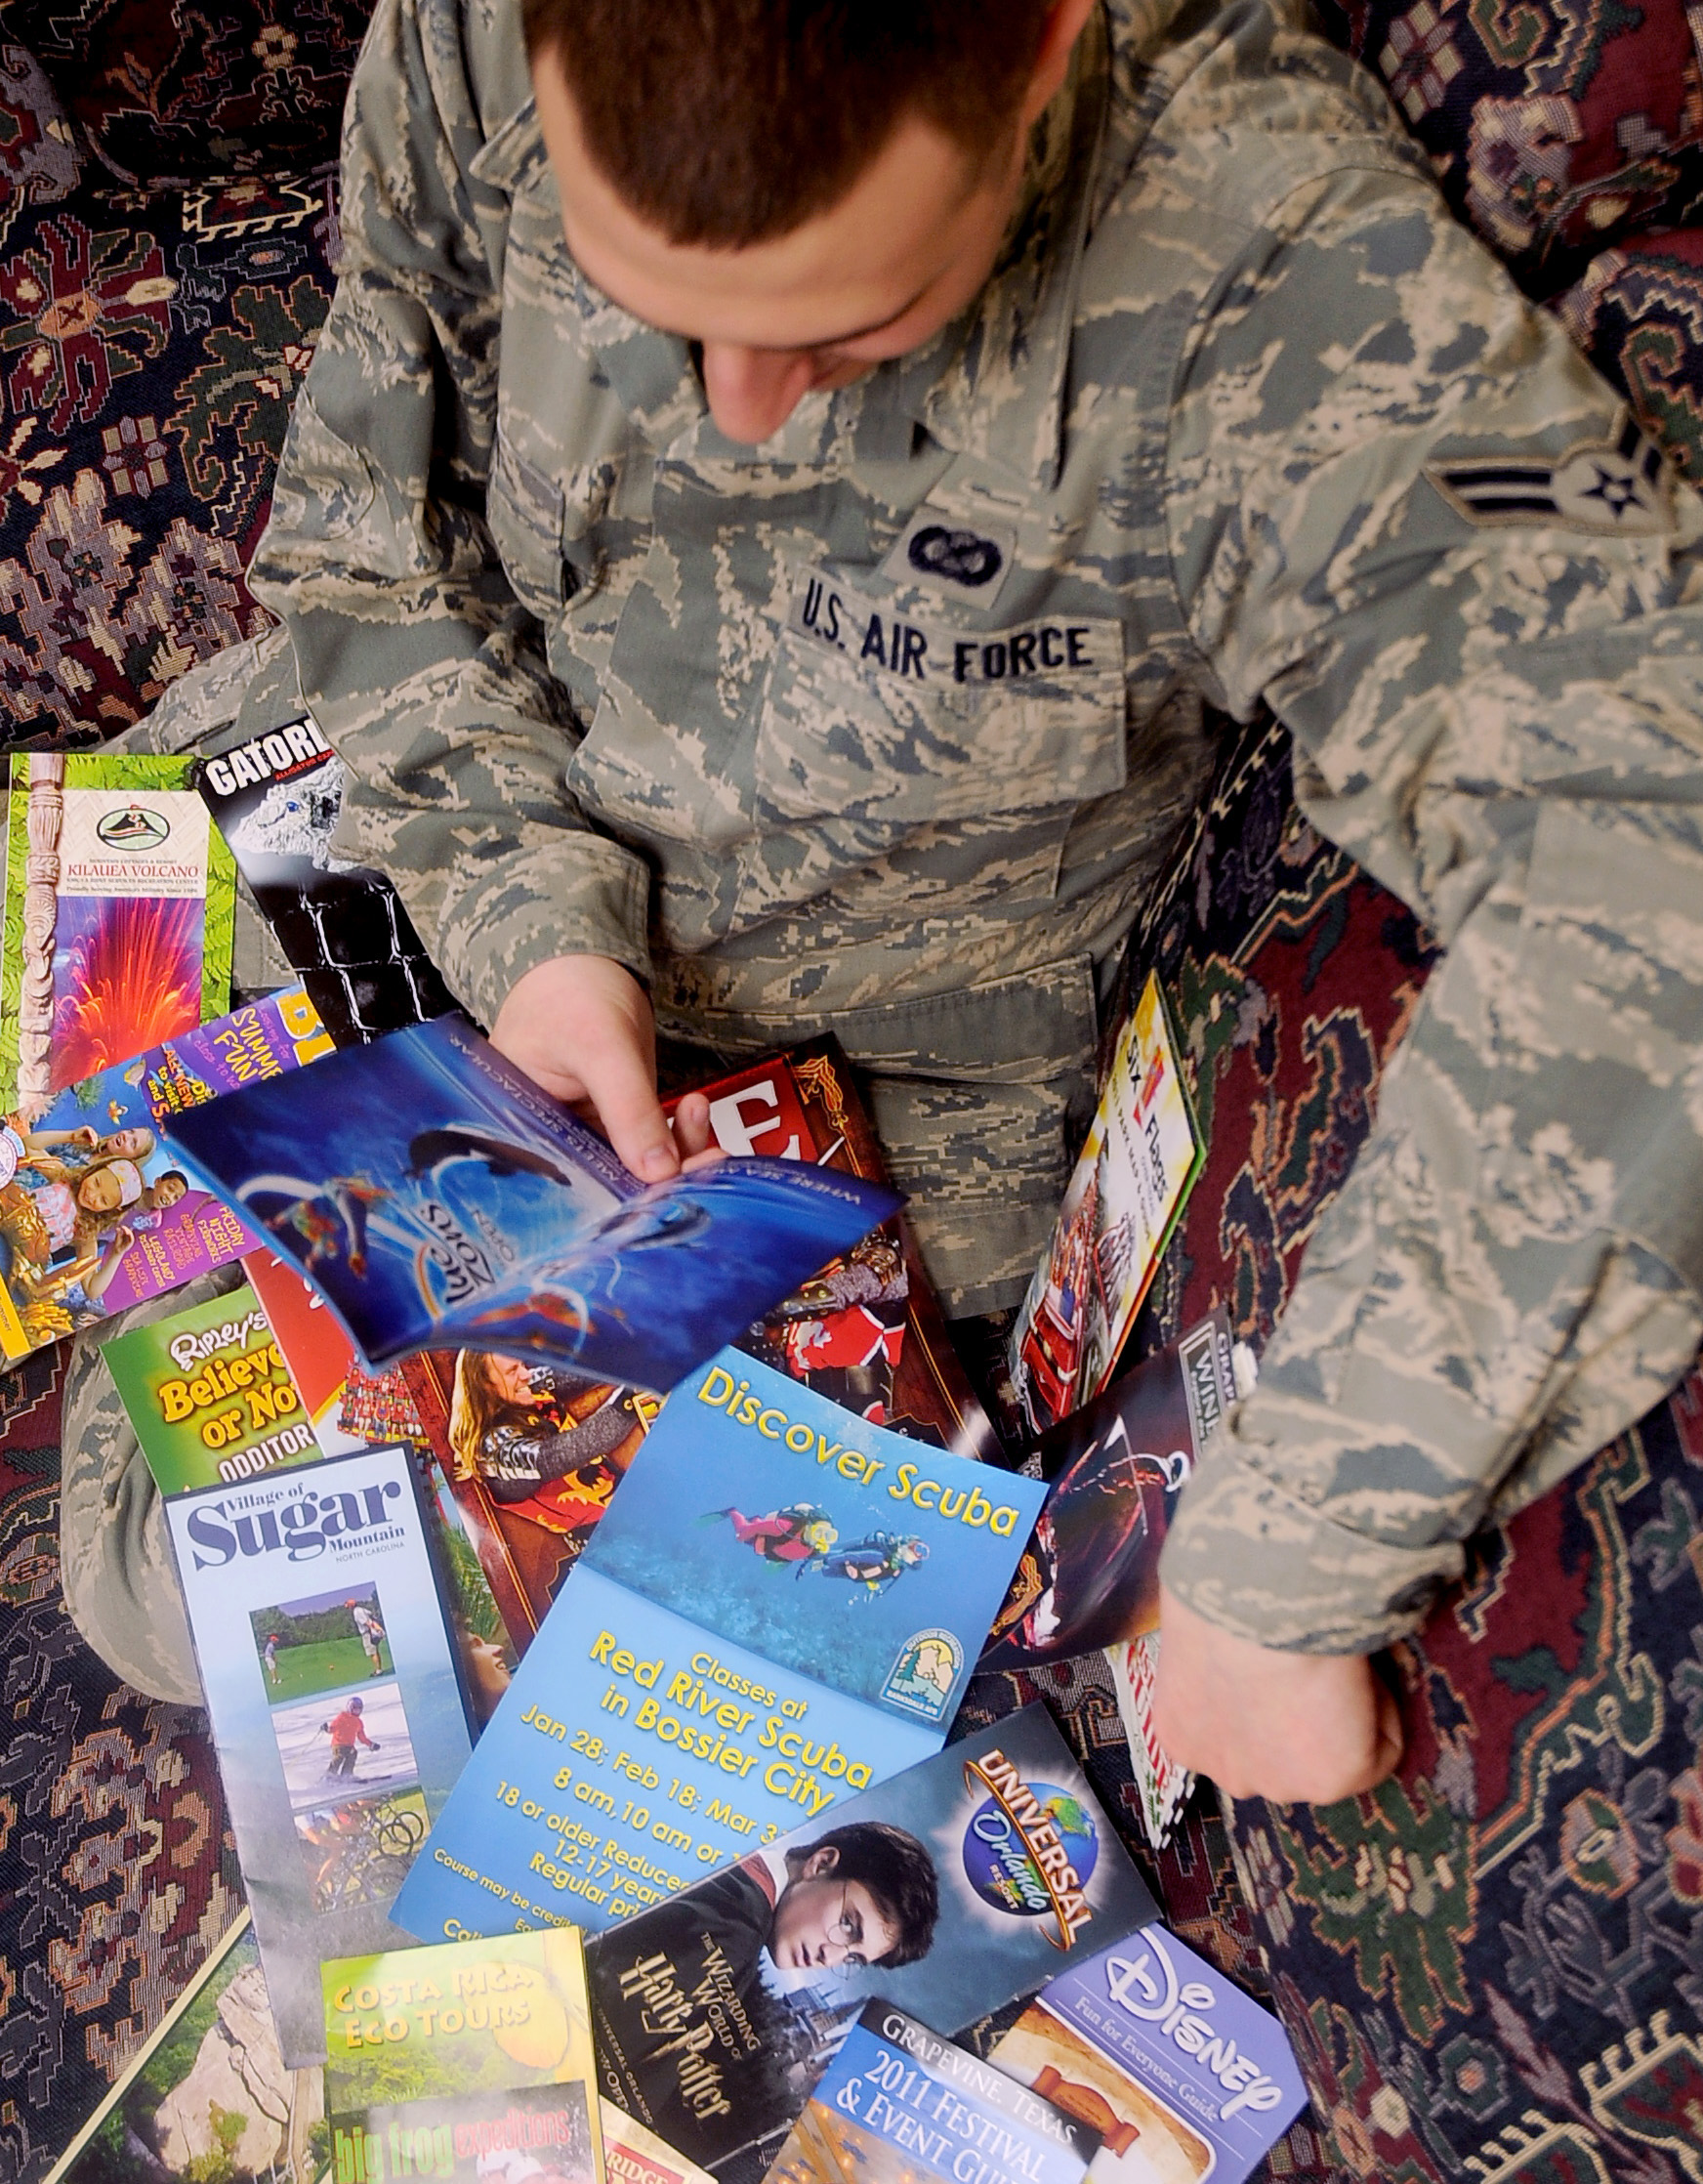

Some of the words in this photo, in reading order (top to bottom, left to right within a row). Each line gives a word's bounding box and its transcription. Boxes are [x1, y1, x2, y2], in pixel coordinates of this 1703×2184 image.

[803, 577, 846, 650] U.S.
[860, 612, 929, 680] AIR
[953, 626, 1093, 683] FORCE
[205, 718, 332, 796] GATORL
[67, 864, 128, 877] KILAUEA
[132, 864, 199, 878] VOLCANO
[146, 1078, 165, 1102] and
[157, 1065, 169, 1080] to
[164, 1048, 183, 1075] ALL
[213, 1029, 259, 1082] FUN
[1126, 1034, 1142, 1095] Six
[162, 1079, 180, 1109] visit
[173, 1073, 196, 1109] NEW
[787, 1172, 863, 1206] WHERE
[1144, 1113, 1169, 1203] Flags
[208, 1217, 234, 1255] NIGHT
[219, 1205, 245, 1246] FRIDAY
[158, 1342, 287, 1423] Believe
[1218, 1331, 1235, 1407] GRAP
[201, 1408, 243, 1449] or
[244, 1381, 297, 1430] No
[219, 1422, 315, 1483] ODDITOR
[697, 1365, 886, 1486] Discover
[888, 1461, 1020, 1538] Scuba
[187, 1481, 402, 1572] Sugar
[225, 1489, 285, 1513] Village
[288, 1482, 304, 1498] of
[328, 1525, 406, 1554] Mountain
[335, 1550, 364, 1564] NORTH
[365, 1540, 406, 1558] CAROLINA
[589, 1629, 666, 1691] Red
[666, 1669, 756, 1736] River
[757, 1715, 874, 1789] Scuba
[689, 1651, 778, 1708] Classes
[780, 1697, 810, 1721] at
[519, 1703, 567, 1742] Jan
[569, 1729, 610, 1766] 28;
[611, 1750, 660, 1790] Feb
[667, 1777, 703, 1813] 18;
[704, 1798, 758, 1837] Mar
[759, 1822, 779, 1845] 3
[600, 1683, 630, 1717] in
[634, 1696, 759, 1779] Bossier
[763, 1761, 837, 1818] City
[495, 1780, 521, 1807] 18
[520, 1799, 546, 1822] or
[545, 1813, 602, 1852] older
[553, 1766, 573, 1790] 8
[573, 1782, 617, 1820] am,
[621, 1800, 651, 1830] 10
[650, 1821, 693, 1854] am
[695, 1842, 724, 1865] or
[976, 1747, 1094, 1946] UNIVERSAL
[433, 1847, 479, 1882] Course
[478, 1874, 512, 1901] may
[510, 1891, 531, 1911] be
[528, 1850, 610, 1906] Regular
[607, 1897, 642, 1919] pri
[554, 1838, 612, 1879] 12-17
[973, 1809, 1052, 1911] Orlando
[988, 1864, 1020, 1911] RESORT
[442, 1917, 484, 1942] Ca
[700, 1931, 716, 1952] THE
[334, 1976, 443, 2013] COSTA
[450, 1962, 534, 1997] RICA
[618, 1951, 695, 2035] Harry
[690, 1976, 736, 2048] WORLD
[700, 1945, 763, 2052] WIZARDING
[344, 2016, 410, 2049] ECO
[415, 2001, 532, 2037] TOURS
[1074, 1995, 1101, 2027] Fun
[1101, 2018, 1123, 2043] for
[1120, 2034, 1179, 2089] Everyone
[1177, 2081, 1221, 2122] Guide
[605, 2071, 631, 2116] OPE
[641, 2020, 732, 2121] Potter
[882, 2013, 1004, 2105] GRAPEVINE,
[1008, 2088, 1079, 2146] TEXAS
[335, 2124, 385, 2184] big
[389, 2120, 455, 2179] frog
[453, 2107, 572, 2162] expeditions
[836, 2077, 863, 2117] &
[861, 2090, 954, 2165] EVENT
[863, 2048, 933, 2112] 2011
[931, 2087, 1048, 2183] FESTIVAL
